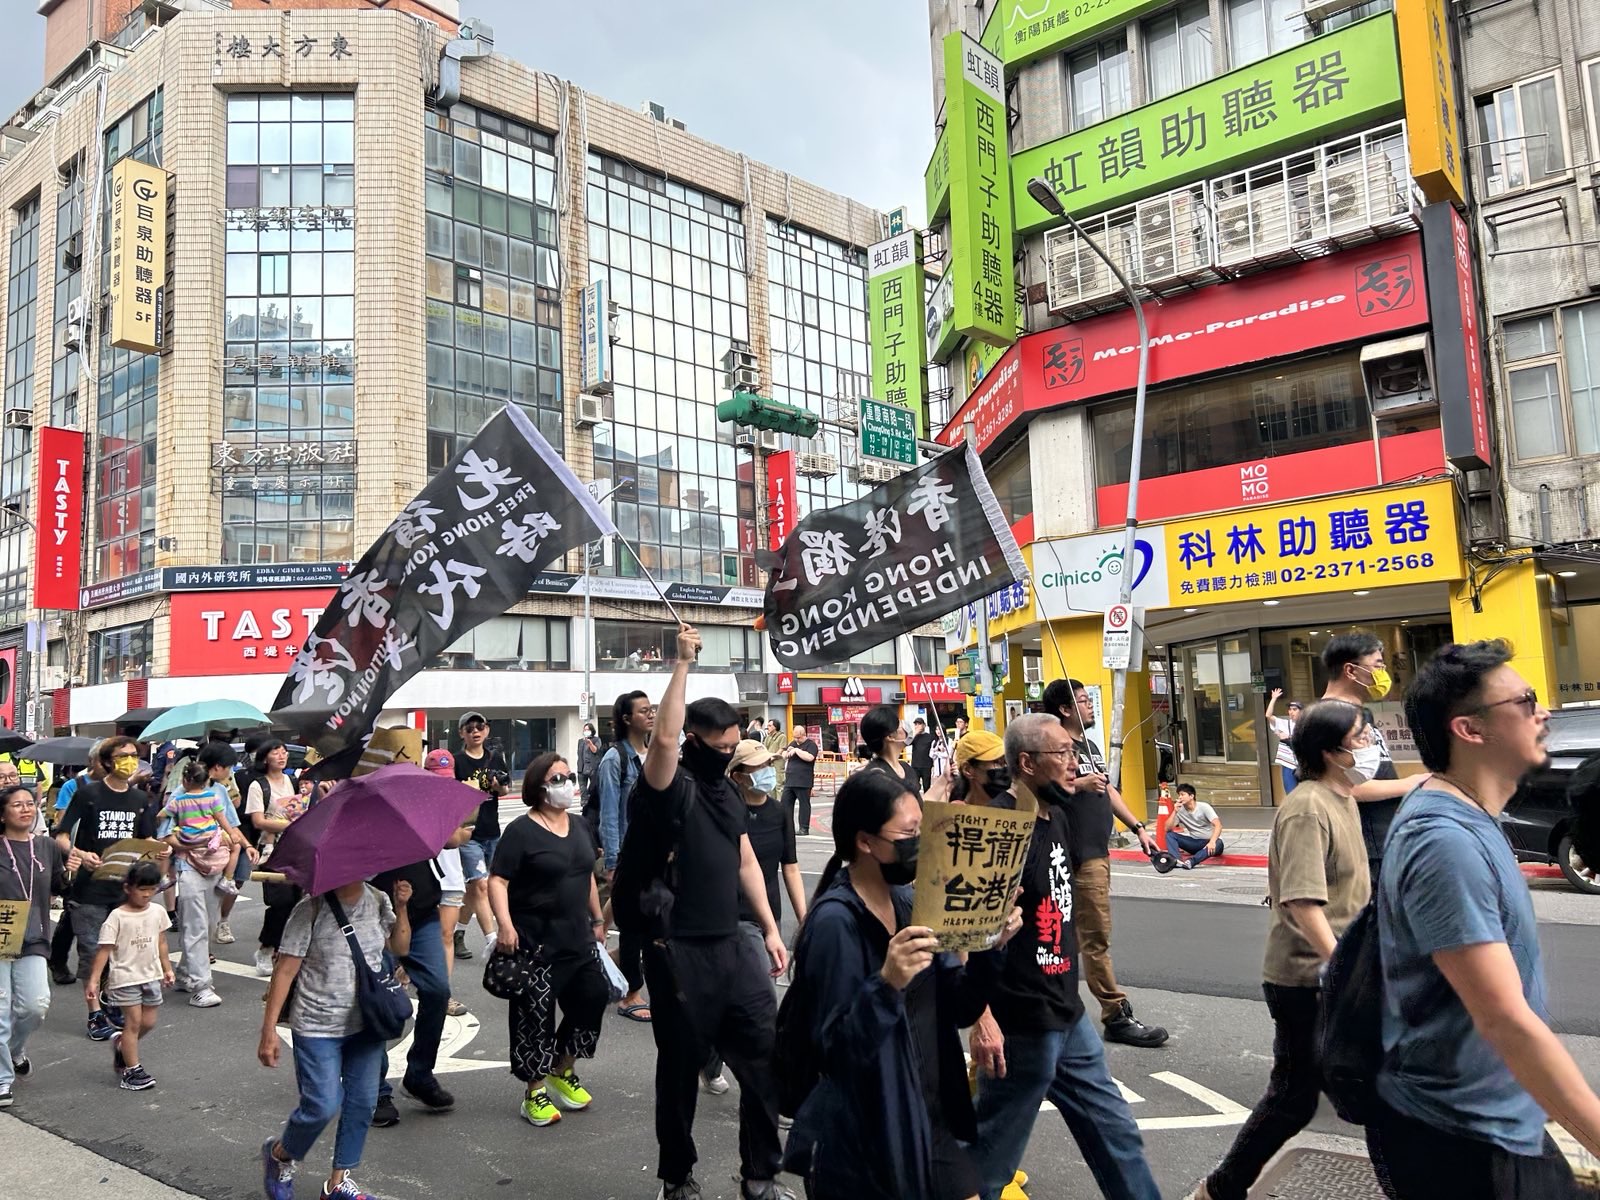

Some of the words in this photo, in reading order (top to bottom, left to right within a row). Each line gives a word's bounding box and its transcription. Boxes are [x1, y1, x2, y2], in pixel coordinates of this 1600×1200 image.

[1014, 9, 1070, 45] 衡陽旗艦
[967, 48, 1000, 93] 虹韻
[1043, 51, 1350, 199] 虹韻助聽器
[975, 97, 1004, 326] 西門子助聽器
[135, 203, 154, 305] 巨泉助聽器
[873, 240, 910, 269] 虹韻
[135, 311, 152, 323] 5F
[1093, 294, 1346, 362] Mo-Mo-Paradise
[865, 402, 912, 430] 重慶南路一段
[212, 440, 355, 467] 東方出版社
[1241, 464, 1267, 480] MO
[53, 459, 71, 545] TASTY
[1242, 481, 1268, 497] MO
[775, 478, 785, 549] TASTY
[1178, 500, 1430, 570] 科林助聽器
[175, 570, 251, 584] 國內外研究所
[1041, 568, 1102, 589] Clinico
[1180, 570, 1277, 595] 免費聽力檢測
[1280, 552, 1434, 583] 02-2371-2568
[912, 682, 946, 694] TASTY
[99, 811, 126, 821] STAND
[126, 812, 136, 821] UP
[954, 814, 989, 826] FIGHT
[995, 819, 1017, 830] FOR
[98, 831, 117, 839] HONG
[1036, 953, 1060, 966] Wife
[1037, 946, 1047, 954] My
